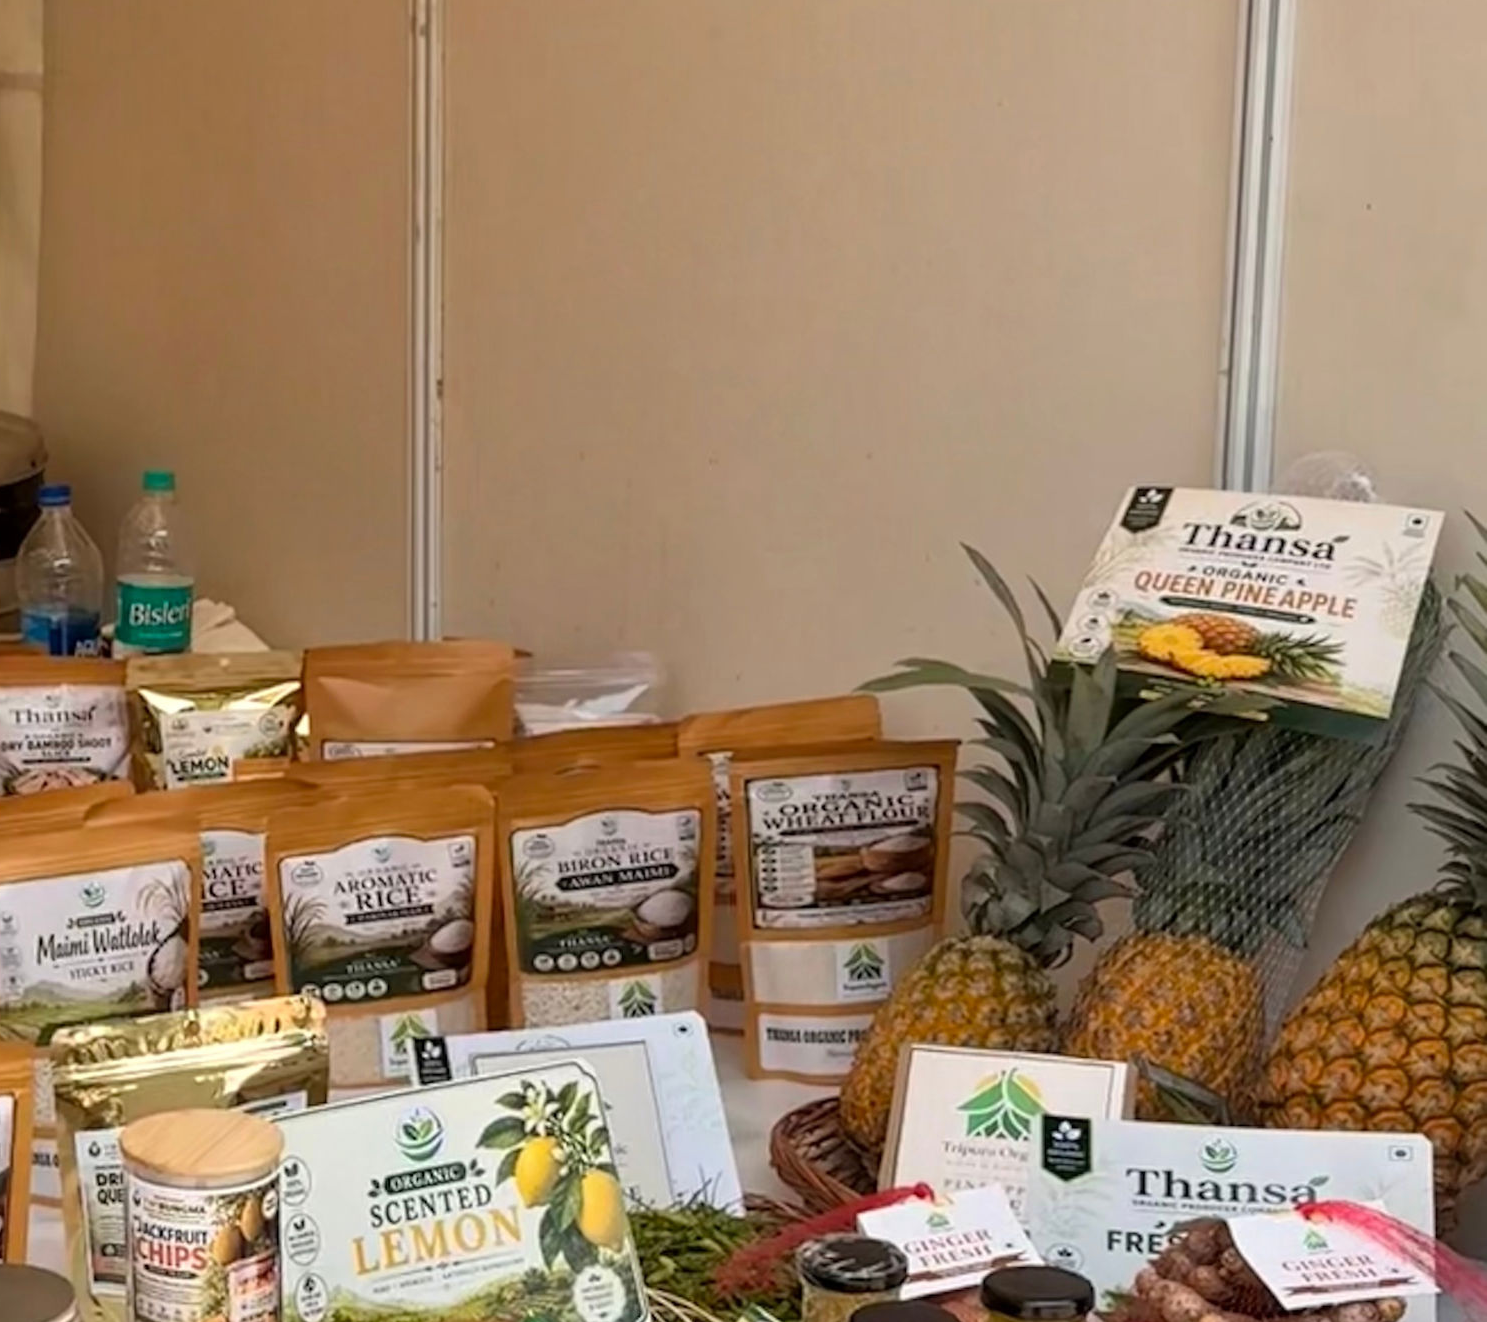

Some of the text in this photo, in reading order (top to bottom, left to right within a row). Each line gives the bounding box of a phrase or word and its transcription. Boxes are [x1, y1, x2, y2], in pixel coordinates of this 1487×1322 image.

[1134, 570, 1215, 598] QUEEN
[1202, 565, 1287, 585] ORGANIC
[170, 756, 229, 774] LEMON
[763, 805, 931, 830] WHEAT FLOUR
[779, 794, 915, 817] ORGANIC
[557, 847, 675, 874] BIRON RICE
[332, 869, 438, 895] AROMATIC
[355, 886, 422, 912] RICE
[390, 1165, 462, 1193] ORGANIC
[370, 1184, 493, 1228] SCENTED
[135, 1216, 208, 1245] JACKFRUIT
[351, 1205, 526, 1278] LEMON
[904, 1229, 993, 1255] GINGER
[136, 1236, 209, 1271] CHIPS
[918, 1245, 993, 1268] FRESH
[1281, 1255, 1374, 1273] GINGER
